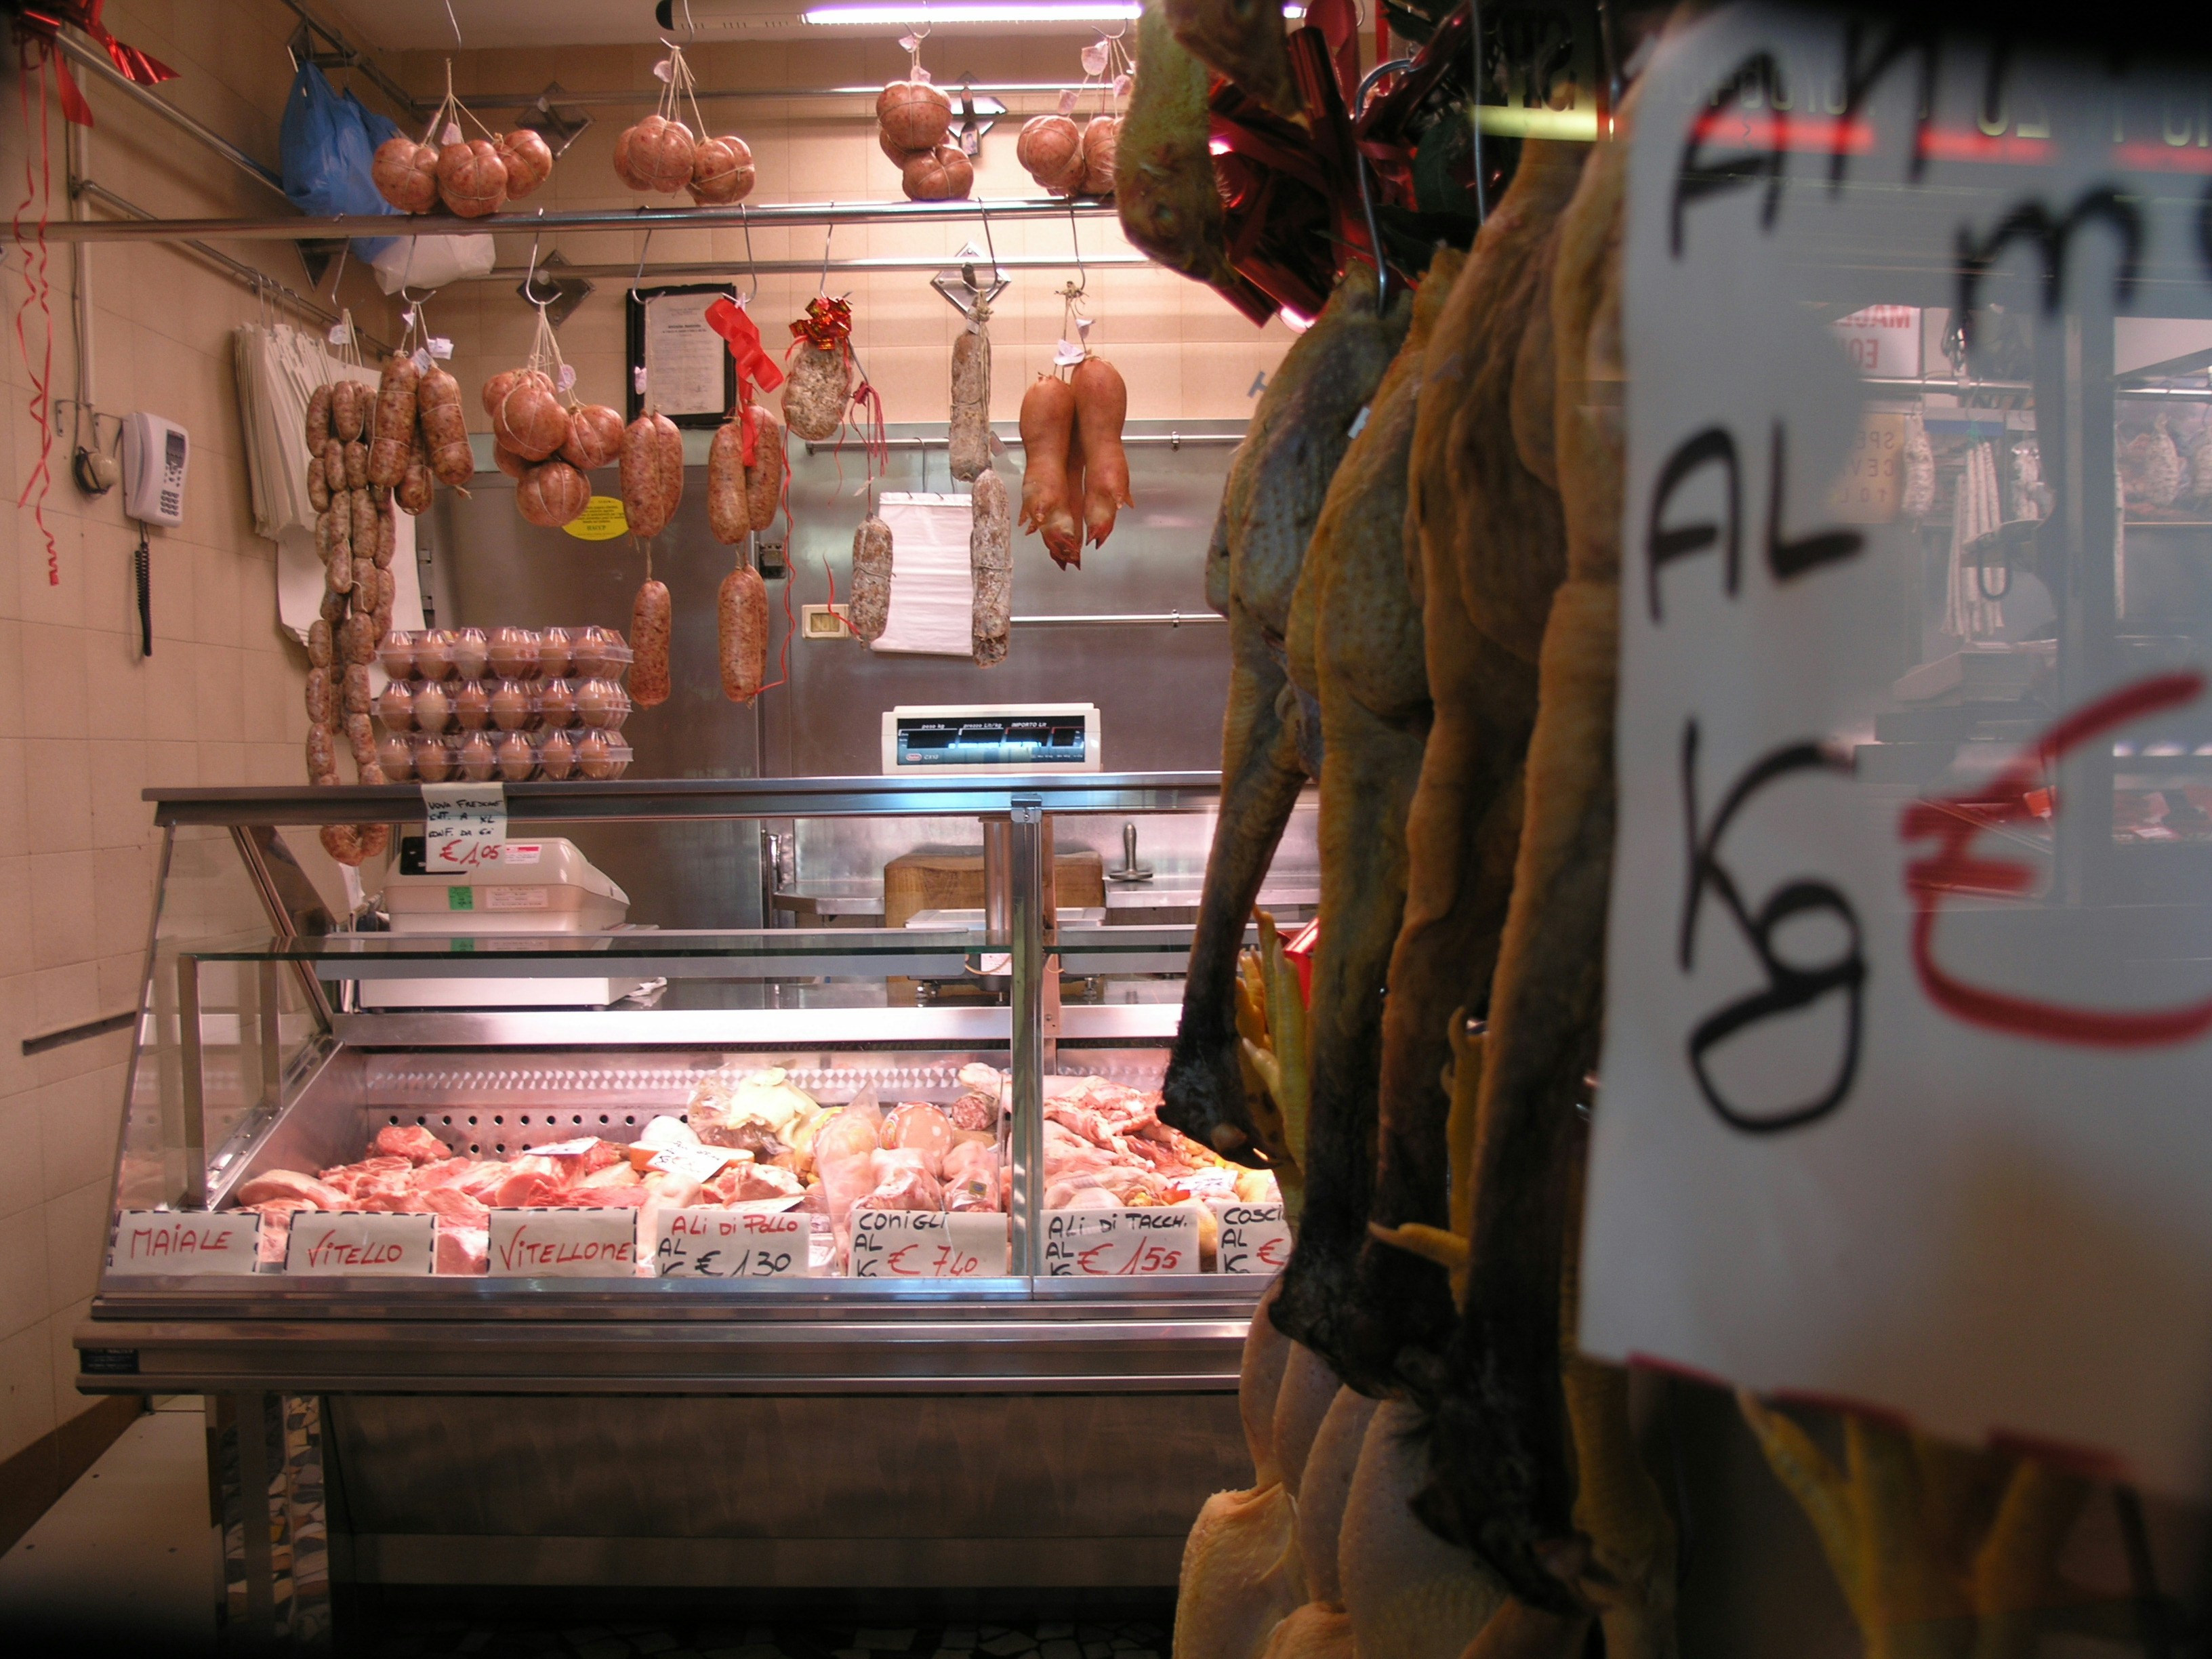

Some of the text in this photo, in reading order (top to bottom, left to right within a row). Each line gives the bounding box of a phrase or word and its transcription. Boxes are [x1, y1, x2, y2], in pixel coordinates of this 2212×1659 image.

[1643, 413, 1867, 626] AL
[658, 1237, 687, 1257] AL
[854, 1233, 884, 1252] AL
[1046, 1241, 1074, 1260] AL
[1221, 1228, 1248, 1249] AL
[1256, 1237, 1285, 1266] €
[694, 1250, 724, 1276] €
[887, 1243, 921, 1275] €
[1077, 1242, 1114, 1275] €
